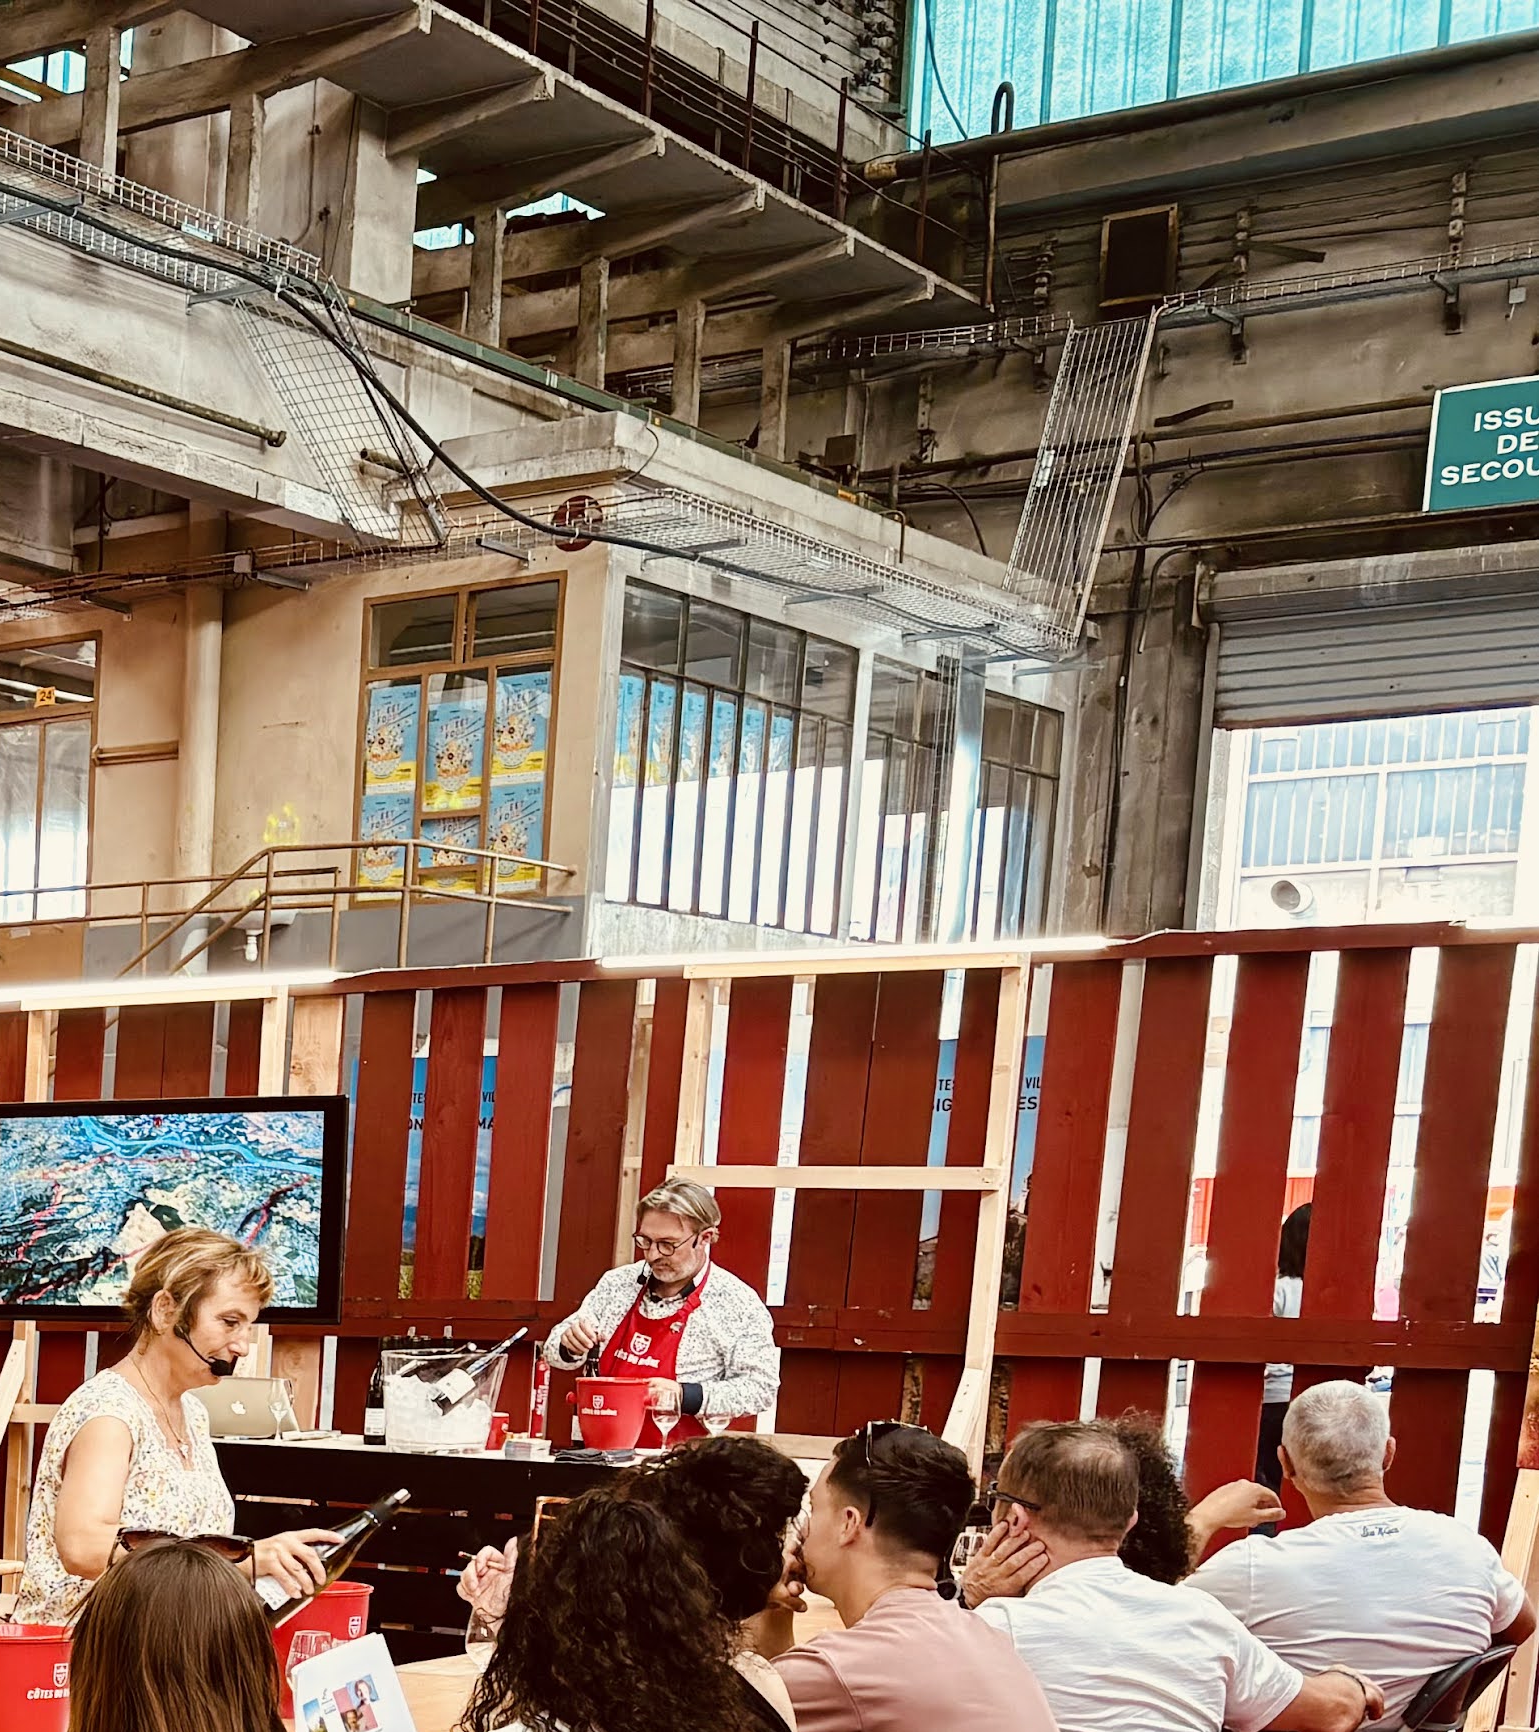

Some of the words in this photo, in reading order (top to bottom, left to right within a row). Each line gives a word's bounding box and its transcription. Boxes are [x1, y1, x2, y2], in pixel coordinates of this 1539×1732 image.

[1473, 405, 1539, 432] ISSU
[1496, 430, 1538, 455] DE
[1440, 456, 1539, 486] SECOU
[38, 690, 53, 702] 24
